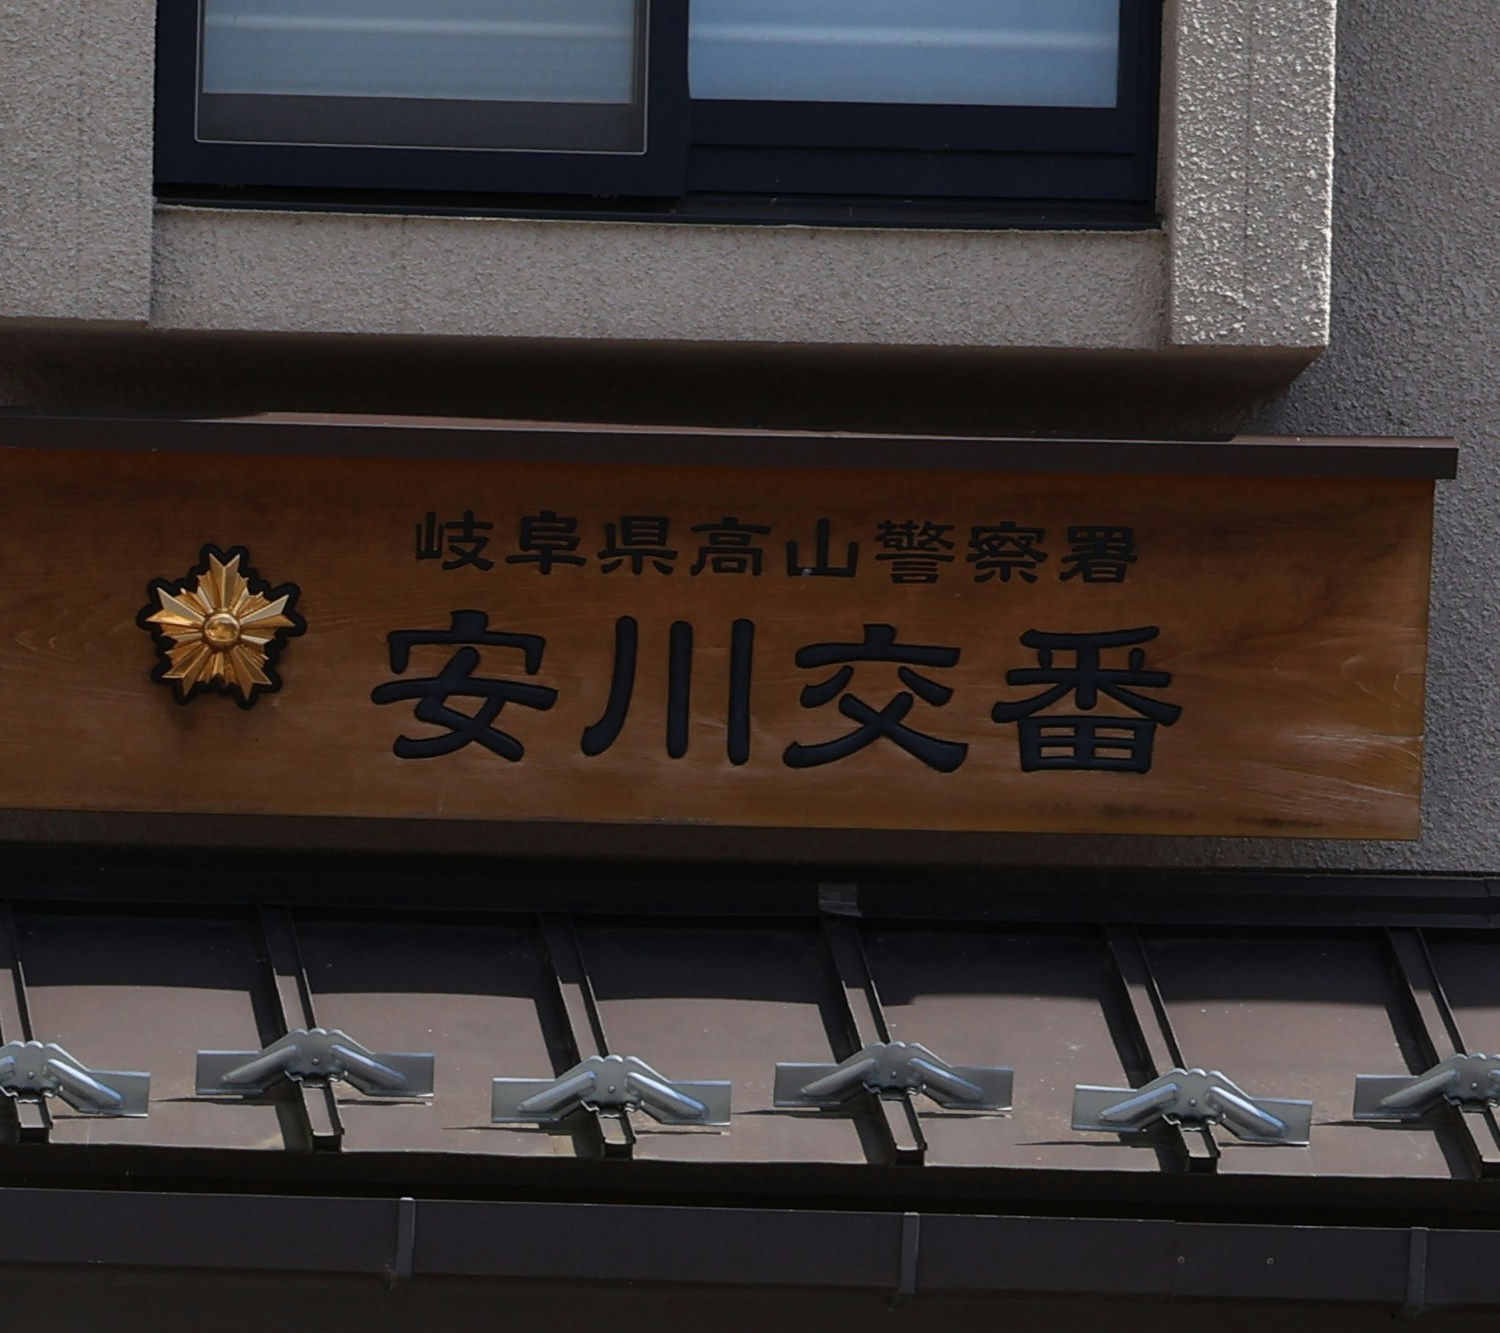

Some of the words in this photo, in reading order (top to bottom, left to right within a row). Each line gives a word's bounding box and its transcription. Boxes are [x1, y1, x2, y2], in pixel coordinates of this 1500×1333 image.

[413, 508, 1142, 586] 岐阜県高山警察署
[368, 609, 1182, 773] 安川交番
